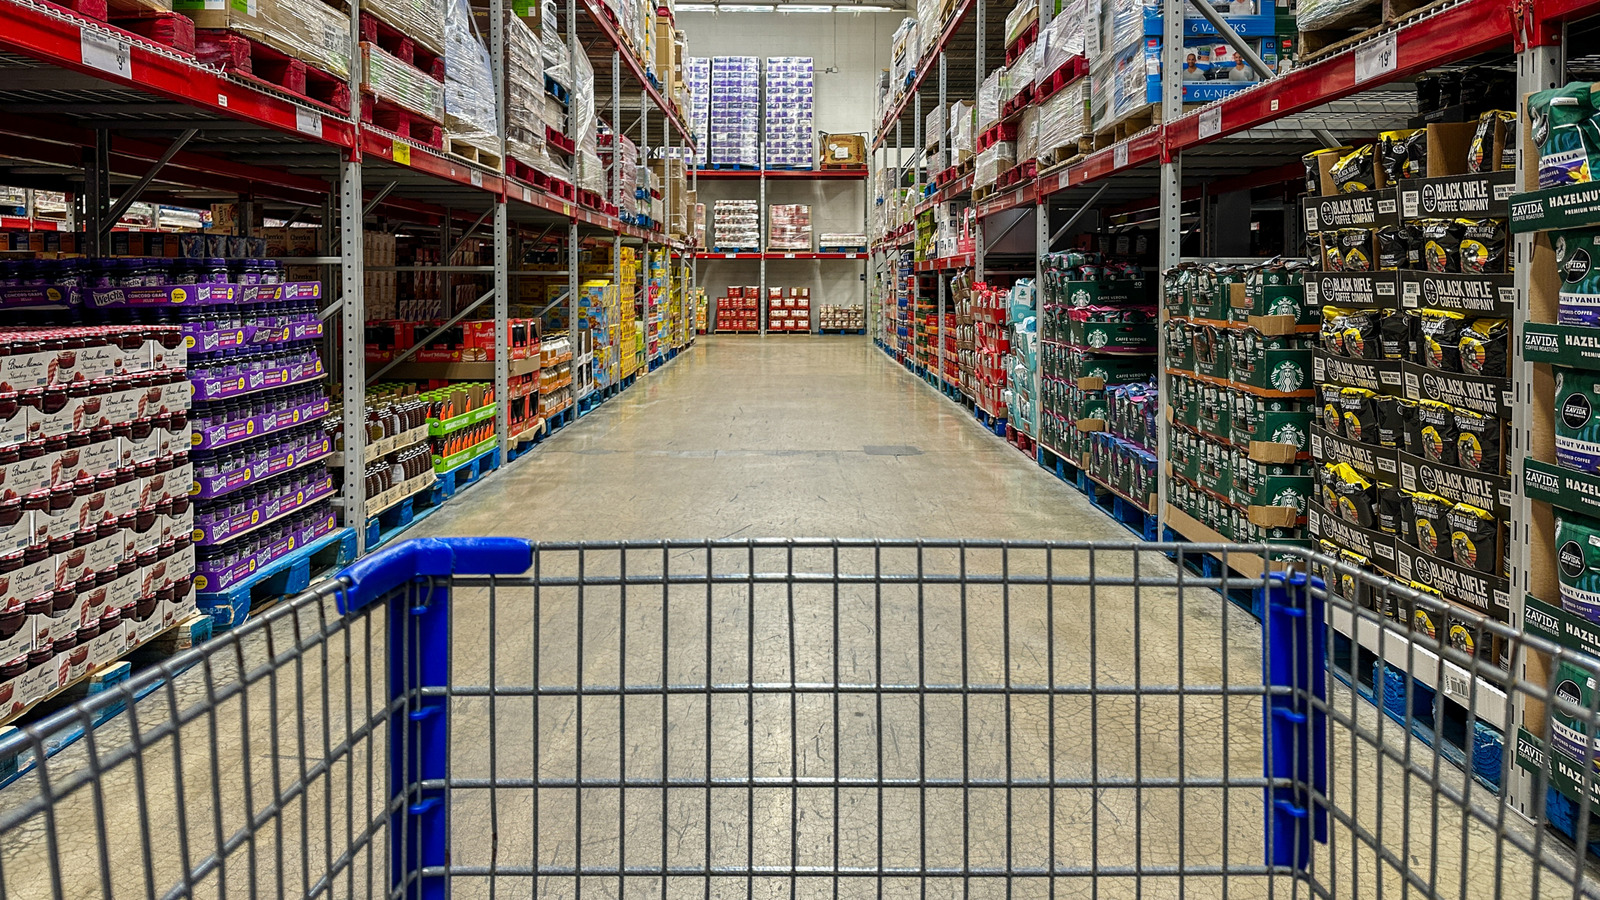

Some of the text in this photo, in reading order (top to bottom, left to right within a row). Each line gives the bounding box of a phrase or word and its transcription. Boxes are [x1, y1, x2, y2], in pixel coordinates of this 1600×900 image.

[1191, 23, 1198, 32] 6
[1193, 89, 1200, 98] 6
[1543, 152, 1578, 165] VANILLA
[1436, 180, 1488, 200] BLACK RIFLE
[1549, 189, 1600, 208] HAZELNU
[1332, 197, 1373, 214] BLACK RIFLE
[1437, 199, 1489, 212] COFFEE COMPANY
[1512, 203, 1544, 216] ZAVIDA
[1565, 207, 1588, 215] PREMIUM
[1335, 212, 1375, 225] COFFEE COMPANY
[1513, 212, 1544, 222] COFFEE ROASTERS
[1333, 278, 1372, 292] BLACK RIFLE
[1436, 280, 1492, 298] BLACK RIFLE
[94, 290, 125, 306] Welch's
[1335, 293, 1373, 303] COFFEE COMPANY
[1440, 297, 1494, 310] COFFEE COMPANY
[1525, 335, 1558, 347] ZAVIDA
[1565, 335, 1600, 348] HAZEL
[1335, 361, 1356, 376] BLACK
[1354, 364, 1376, 379] RIFLE
[1339, 374, 1356, 385] COFFEE
[1356, 378, 1379, 390] COMPANY
[1436, 376, 1495, 401] BLACK RIFLE
[1441, 393, 1497, 414] COFFEE COMPANY
[1565, 406, 1586, 415] ZAVIDA
[1333, 440, 1373, 464] BLACK RIFLE
[1337, 454, 1352, 467] COFFEE
[1352, 460, 1375, 474] COMPANY
[1434, 469, 1492, 498] BLACK RIFLE
[1525, 471, 1559, 488] ZAVIDA
[1526, 481, 1559, 494] COFFEE ROASTERS
[1566, 478, 1600, 497] HAZEL
[1439, 486, 1494, 511] COFFEE COMPANY
[1331, 519, 1370, 548] BLACK RIFLE
[1334, 533, 1350, 548] COFFEE
[1350, 541, 1373, 558] COMPANY
[1430, 562, 1487, 597] BLACK RIFLE
[1434, 579, 1456, 597] COFFEE
[1457, 588, 1489, 610] COMPANY
[1525, 608, 1559, 632] ZAVIDA
[1526, 618, 1539, 628] COFFEE
[1566, 622, 1600, 647] HAZEL
